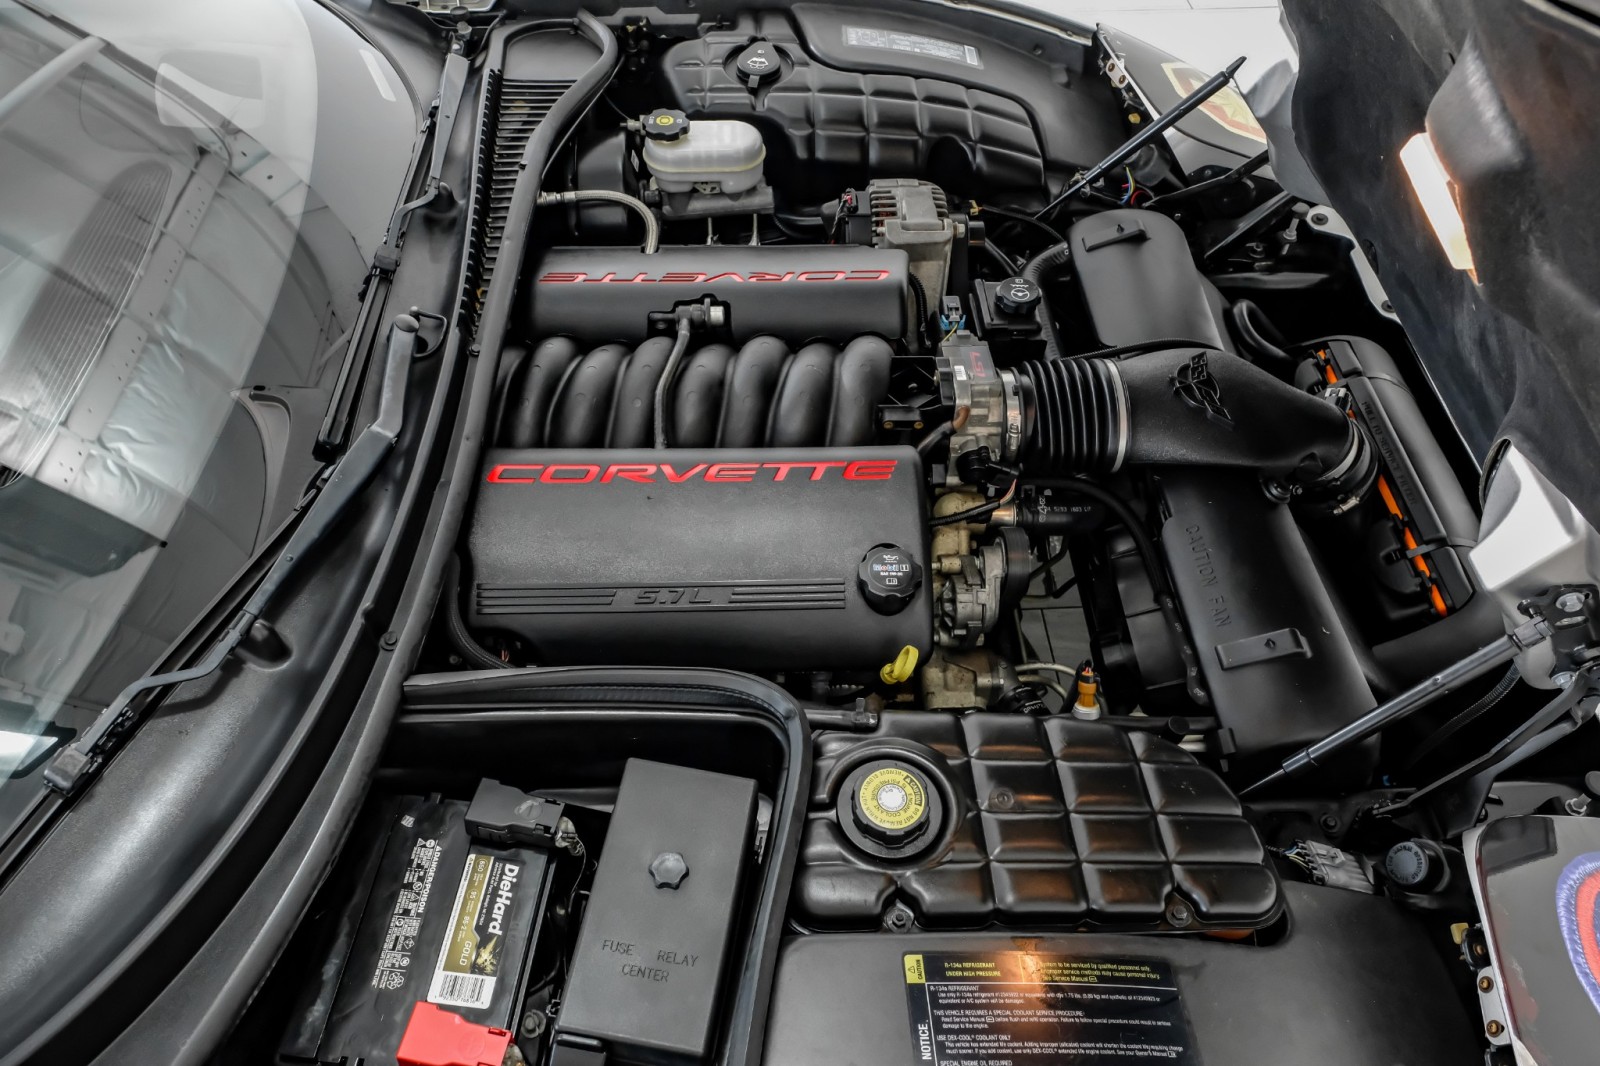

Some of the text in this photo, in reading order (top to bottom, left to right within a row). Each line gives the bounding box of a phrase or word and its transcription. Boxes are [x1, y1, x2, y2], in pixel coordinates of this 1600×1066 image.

[538, 270, 890, 283] CORVETTE
[487, 460, 898, 484] CORVETTE
[1185, 525, 1232, 628] CAUTION FAN
[634, 588, 712, 605] 5.7L
[864, 774, 879, 790] SLOWLY
[904, 792, 914, 814] ENGINE
[910, 782, 922, 805] CAUTION
[874, 804, 902, 818] COOLANT
[904, 814, 914, 824] NOT
[912, 808, 920, 816] DO
[418, 851, 441, 914] DANGER/POISON
[470, 891, 477, 900] 95
[488, 863, 520, 936] DieHard
[460, 940, 472, 966] GOLD
[602, 940, 699, 967] FUSE RELAY
[622, 964, 670, 982] CENTER
